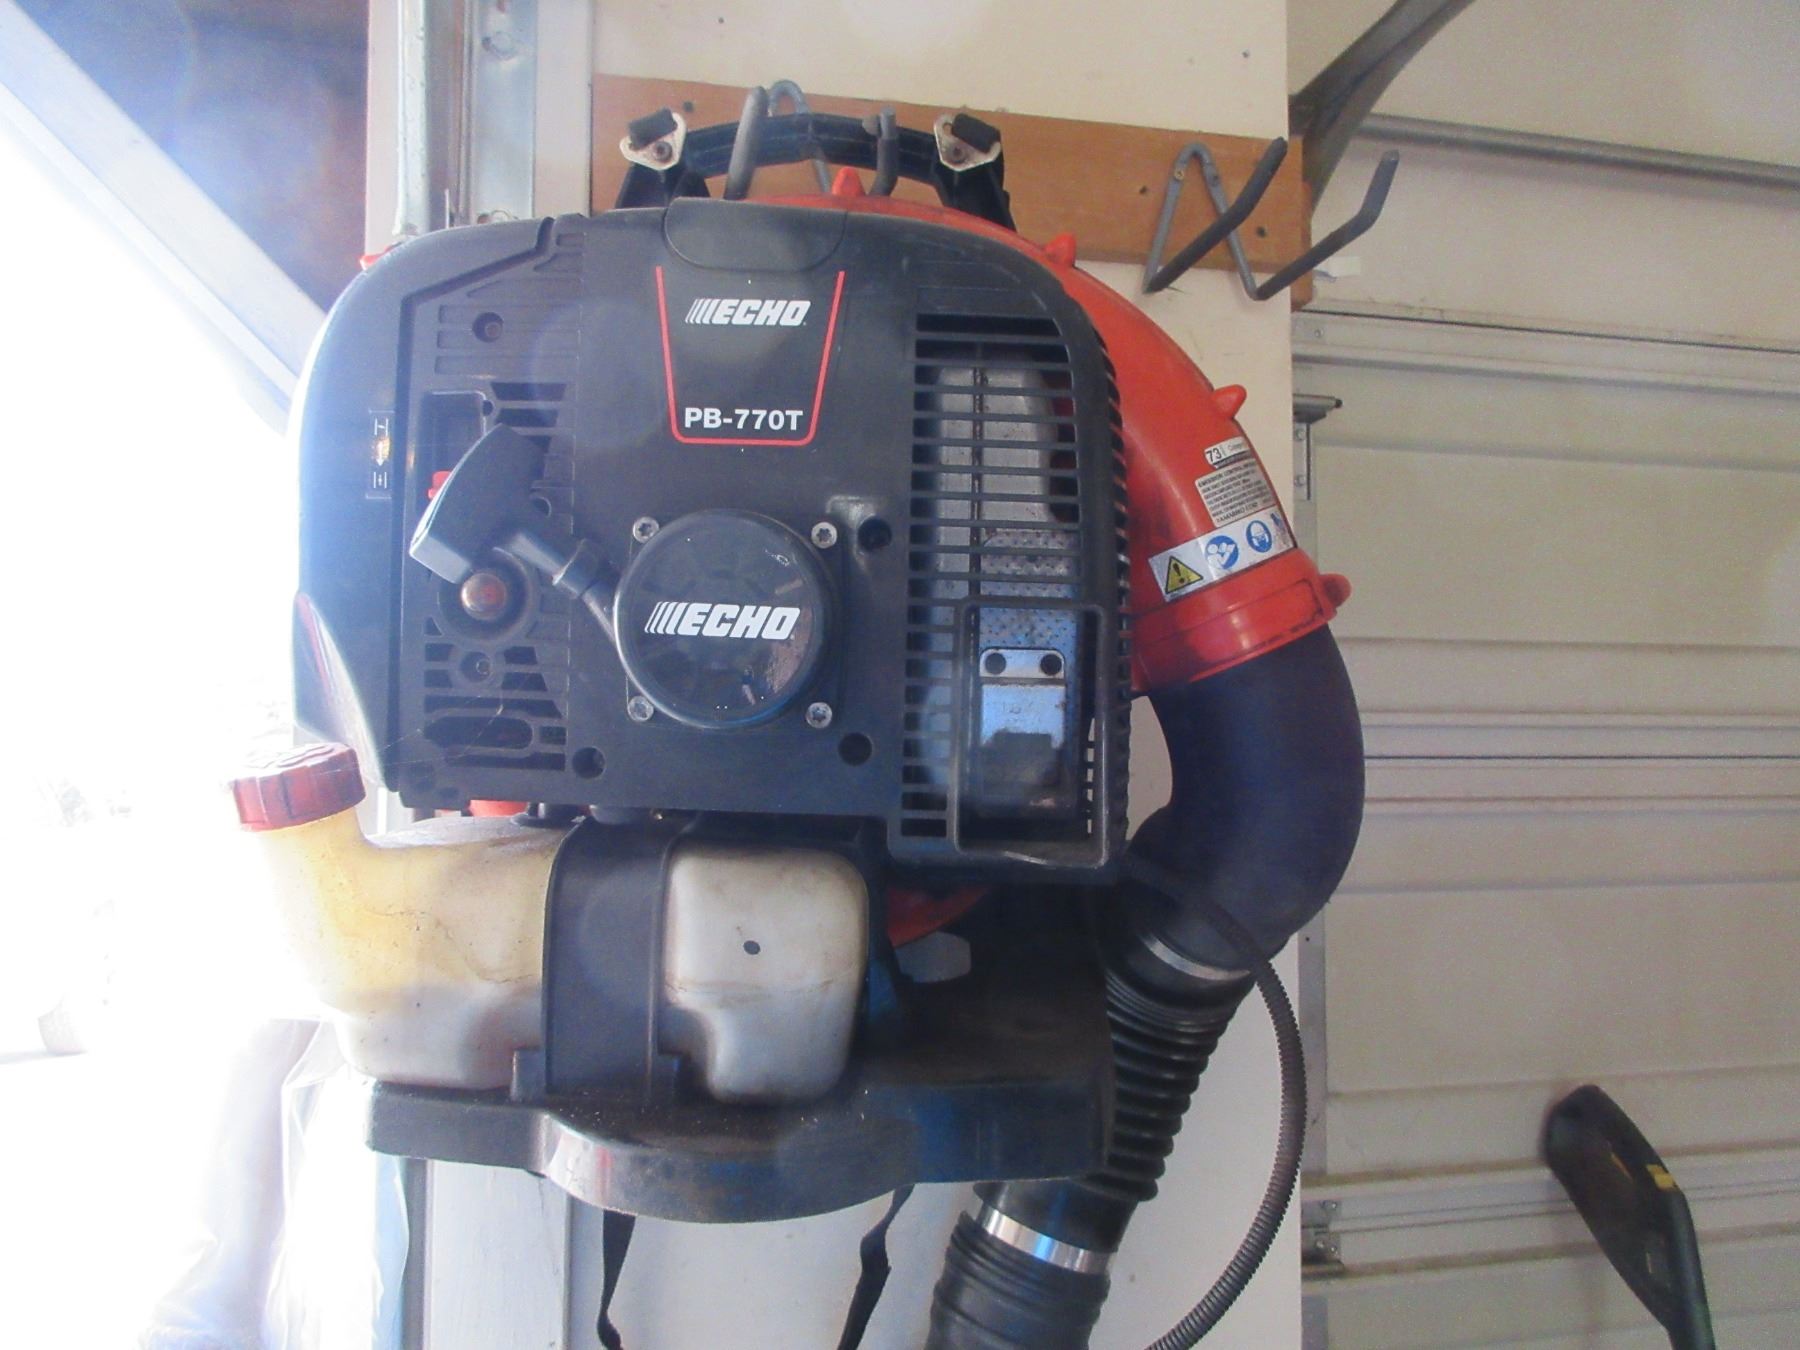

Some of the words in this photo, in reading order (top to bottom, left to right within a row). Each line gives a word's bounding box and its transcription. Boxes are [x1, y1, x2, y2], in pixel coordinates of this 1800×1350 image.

[711, 298, 811, 326] ECHO
[684, 407, 803, 430] PB-770T
[1206, 448, 1222, 462] 73
[677, 602, 801, 640] ECHO
